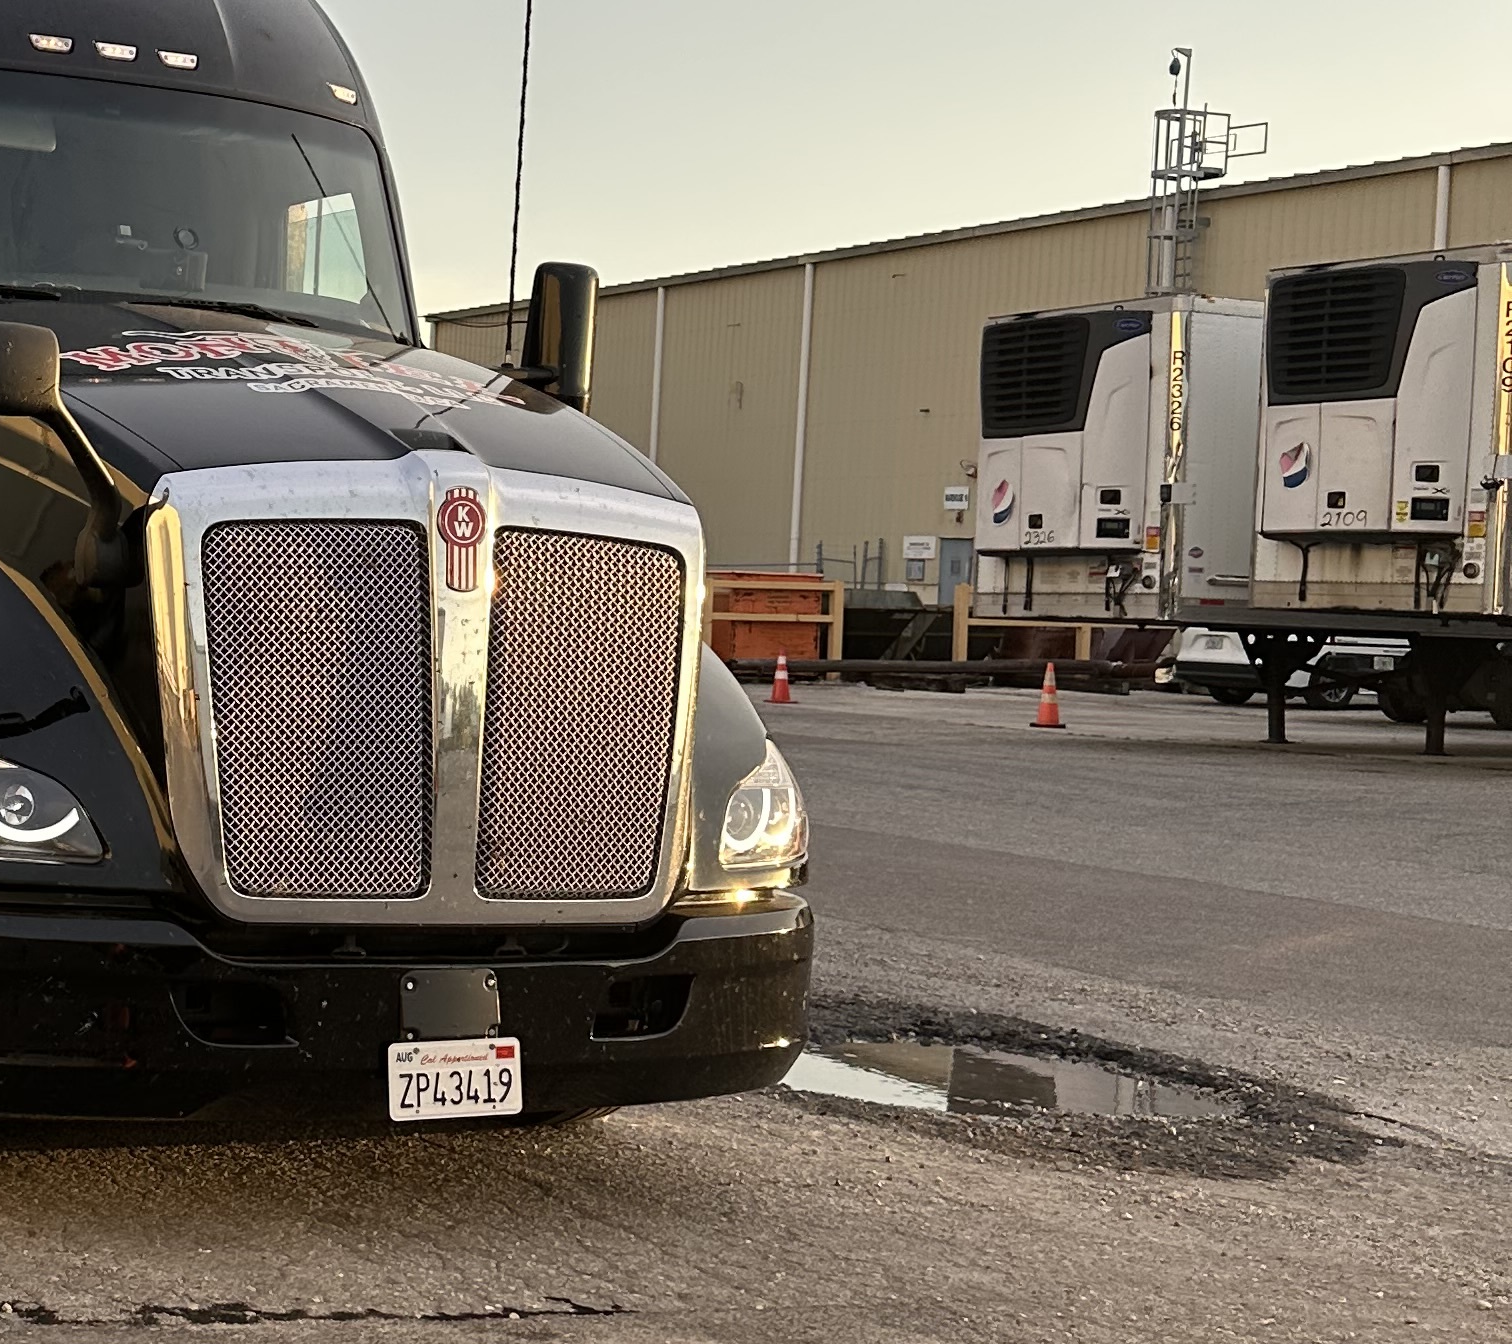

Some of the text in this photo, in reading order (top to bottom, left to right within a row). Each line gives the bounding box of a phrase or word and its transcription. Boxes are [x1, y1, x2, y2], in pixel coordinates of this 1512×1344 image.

[1170, 350, 1186, 431] R2326
[1320, 509, 1368, 527] 2109
[1023, 530, 1056, 545] 2326
[396, 1052, 414, 1063] AUG
[399, 1068, 513, 1109] ZP43419
